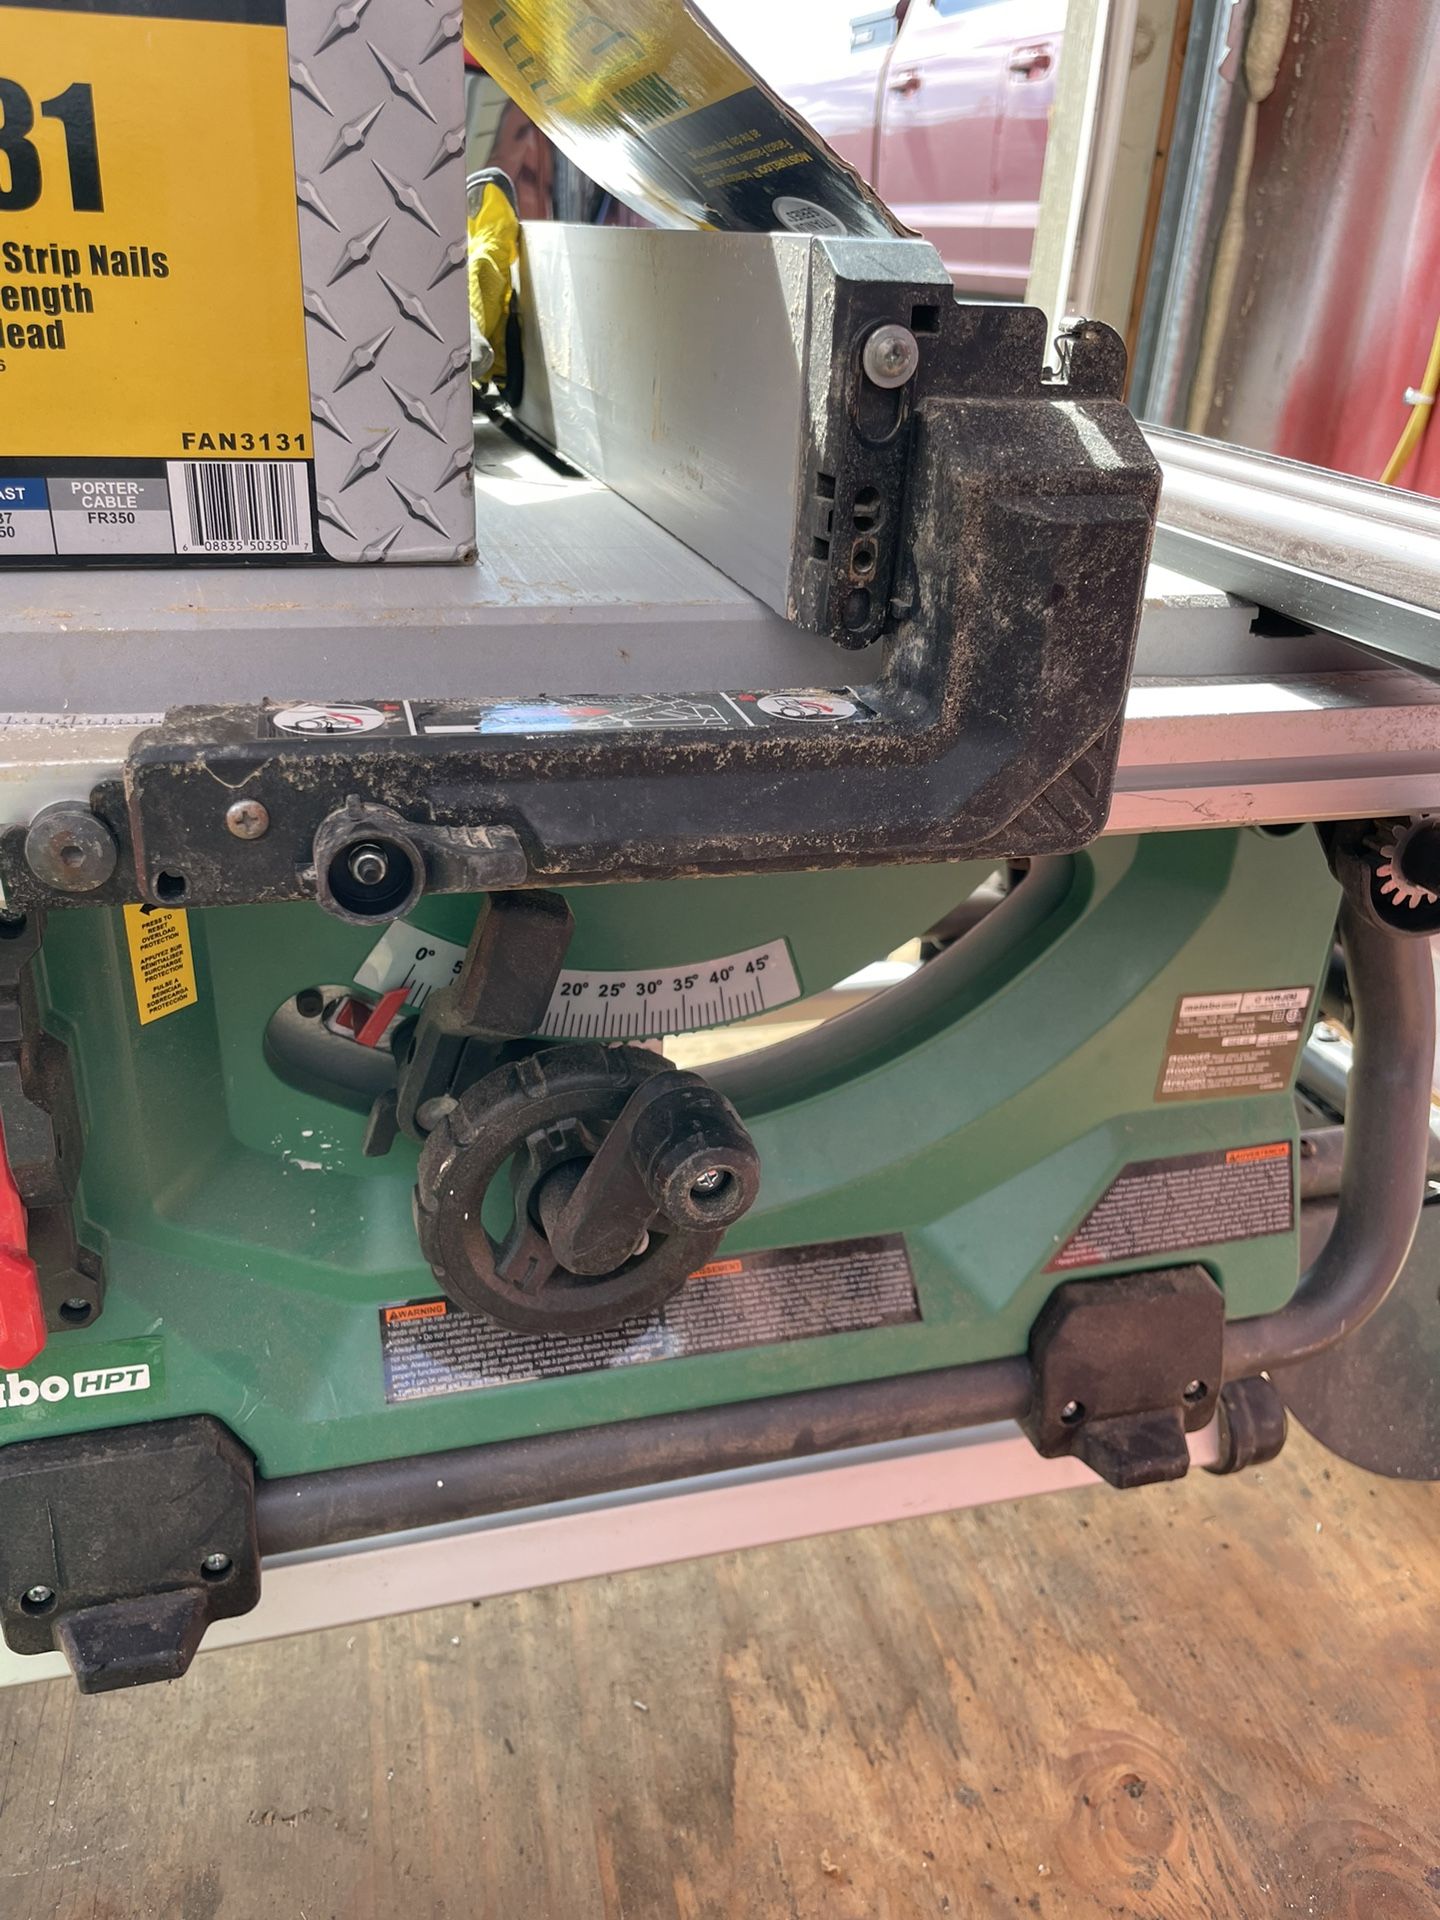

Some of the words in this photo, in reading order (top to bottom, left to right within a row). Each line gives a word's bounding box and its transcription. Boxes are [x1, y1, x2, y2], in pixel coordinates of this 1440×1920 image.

[2, 241, 81, 278] Strip
[88, 244, 169, 278] Nails
[182, 432, 306, 451] FAN3131
[71, 481, 145, 496] PORTER-
[82, 495, 137, 509] CABLE
[88, 512, 135, 525] FR350
[183, 544, 188, 552] 6
[205, 540, 243, 551] 08835
[250, 540, 288, 551] 50350
[304, 543, 309, 551] 7
[142, 917, 162, 929] PRESS
[163, 913, 172, 921] TO
[147, 922, 168, 934] RESET
[140, 932, 179, 951] PROTECTION
[142, 926, 176, 943] OVERLOAD
[141, 949, 168, 964] APPUYEZ
[145, 964, 183, 983] PROTECTION
[415, 947, 436, 961] 0°
[560, 982, 589, 996] 20°
[599, 982, 626, 997] 25°
[636, 980, 663, 996] 30°
[673, 974, 699, 991] 35°
[709, 966, 735, 984] 40°
[745, 955, 769, 974] 45°
[398, 1304, 443, 1318] WARNING
[80, 1369, 144, 1393] HPT
